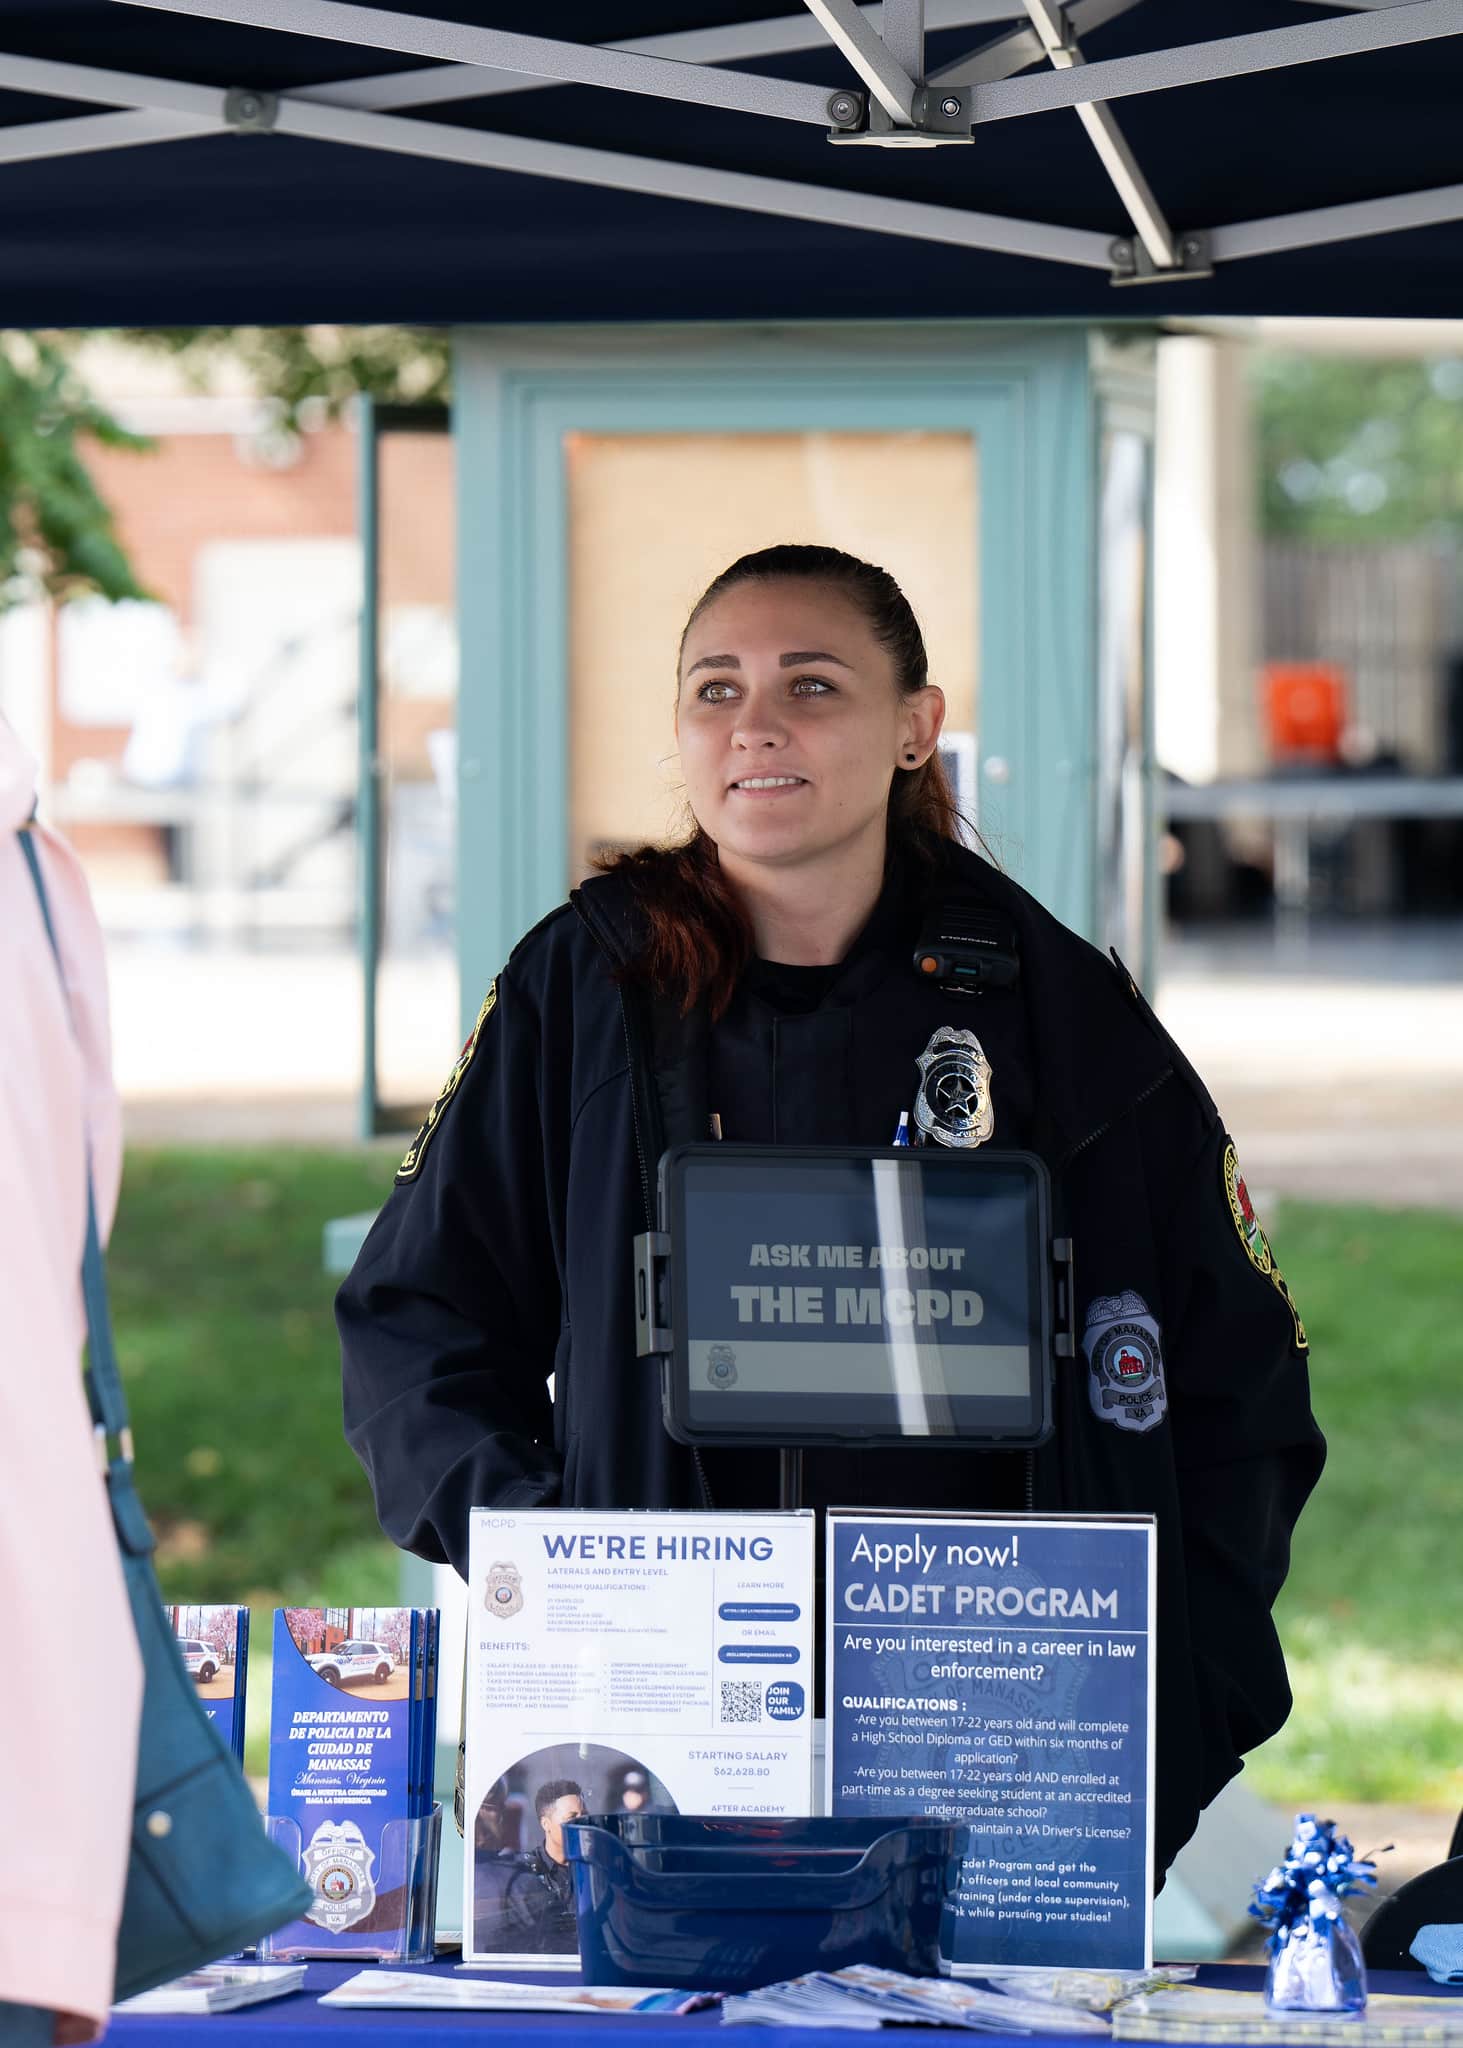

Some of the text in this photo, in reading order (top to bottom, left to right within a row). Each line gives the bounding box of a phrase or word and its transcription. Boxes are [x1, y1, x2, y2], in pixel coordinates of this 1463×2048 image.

[749, 1243, 965, 1271] ASK ME ABOUT
[730, 1285, 984, 1327] THE MCPD
[1118, 1391, 1153, 1405] POLICE
[1134, 1407, 1146, 1418] VA
[481, 1519, 516, 1529] MCPD
[543, 1535, 773, 1561] WE'RE HIRING
[851, 1533, 1019, 1574] Apply now!
[612, 1568, 641, 1576] ENTRY
[844, 1583, 1118, 1619] CADET PROGRAM
[480, 1641, 530, 1651] BENEFITS:
[843, 1634, 1137, 1658] Are you interested in a career in law
[930, 1661, 1044, 1681] enforcement?
[768, 1687, 789, 1695] JOIN
[768, 1697, 788, 1705] OUR
[842, 1696, 958, 1711] QUALIFICATIONS
[292, 1711, 389, 1723] DEPARTAMENTO
[768, 1706, 801, 1716] FAMILY
[879, 1716, 899, 1728] you
[901, 1715, 948, 1728] between
[951, 1717, 981, 1729] 17-22
[983, 1719, 1014, 1732] years
[1015, 1719, 1033, 1731] old
[1035, 1720, 1056, 1731] and
[1058, 1720, 1076, 1732] will
[1078, 1721, 1129, 1735] complete
[289, 1727, 392, 1739] DE POLICIA DE LA
[851, 1731, 1123, 1750] a High School Diploma or GED within six months of
[307, 1743, 374, 1755] CIUDAD DE
[688, 1751, 788, 1761] STARTING SALARY
[308, 1759, 372, 1771] MANASSAS
[954, 1752, 1019, 1766] application?
[346, 1771, 386, 1788] Virginia
[878, 1768, 898, 1780] you
[900, 1768, 947, 1780] between
[950, 1769, 981, 1781] 17-22
[983, 1772, 1012, 1784] years
[1014, 1771, 1032, 1783] old
[1034, 1772, 1059, 1783] AND
[1061, 1773, 1106, 1785] enrolled
[1108, 1775, 1120, 1786] at
[841, 1784, 1132, 1804] part-time as a degree seeking student at an accredited
[740, 1805, 785, 1813] ACADEMY
[924, 1804, 1048, 1819] undergraduate school?
[1015, 1826, 1023, 1836] a
[1024, 1825, 1040, 1836] VA
[1042, 1826, 1082, 1838] Driver's
[1085, 1827, 1132, 1839] License?
[962, 1859, 1097, 1874] adet Program and get the
[968, 1874, 1009, 1888] officers
[1011, 1876, 1031, 1887] and
[1034, 1876, 1060, 1888] local
[1063, 1879, 1120, 1893] community
[959, 1891, 1130, 1909] raining (under close supervision),
[968, 1907, 995, 1918] while
[998, 1910, 1042, 1922] pursuing
[1045, 1911, 1067, 1923] your
[1070, 1911, 1111, 1923] studies!
